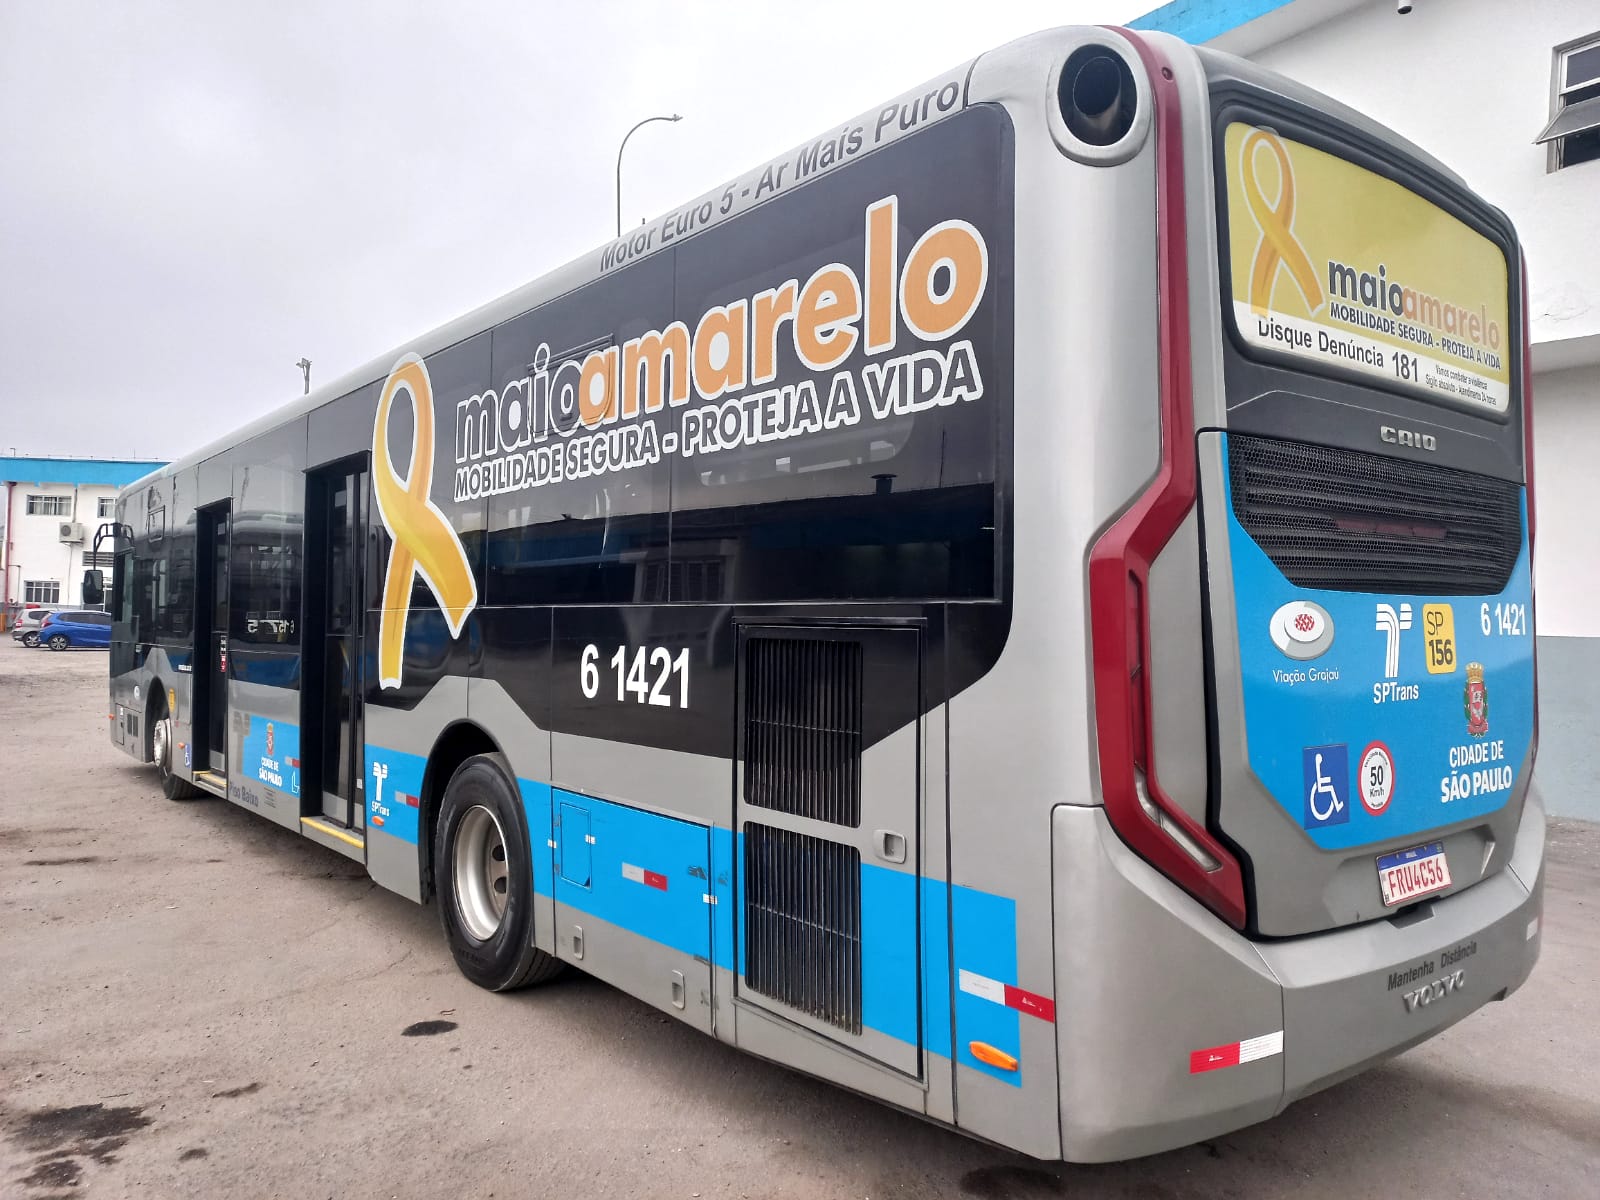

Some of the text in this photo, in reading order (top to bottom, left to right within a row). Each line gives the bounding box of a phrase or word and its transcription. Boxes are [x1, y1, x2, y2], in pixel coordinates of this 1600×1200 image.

[600, 224, 657, 272] Motor
[661, 200, 712, 243] Euro
[720, 183, 737, 215] 5
[754, 159, 789, 200] Ar
[795, 126, 864, 180] Mais
[874, 81, 959, 143] Puro
[1258, 318, 1418, 382] Disque Denúncia 181
[1331, 302, 1395, 335] MOBILIDADE
[1398, 323, 1433, 347] SEGURA
[1442, 338, 1475, 360] PROTEJA
[1477, 350, 1482, 363] A
[1483, 352, 1501, 370] VIDA
[453, 444, 563, 502] MOBILIDADE
[565, 420, 659, 475] SEGURA
[682, 379, 822, 458] PROTEJA
[825, 370, 861, 426] A
[862, 340, 983, 418] VIDA
[1381, 426, 1436, 451] CAIO
[1427, 611, 1444, 636] SP
[1481, 602, 1526, 636] 6 1421
[1429, 639, 1453, 666] 156
[581, 644, 690, 709] 6 1421
[1273, 667, 1339, 686] Viação Grajaú
[1373, 682, 1419, 704] SPTrans
[1449, 740, 1504, 767] CIDADE DE
[1370, 765, 1383, 786] 50
[1441, 765, 1512, 803] SÃO PAULO
[1388, 857, 1443, 897] FRU4C56
[1388, 941, 1477, 991] Mantenha Distância
